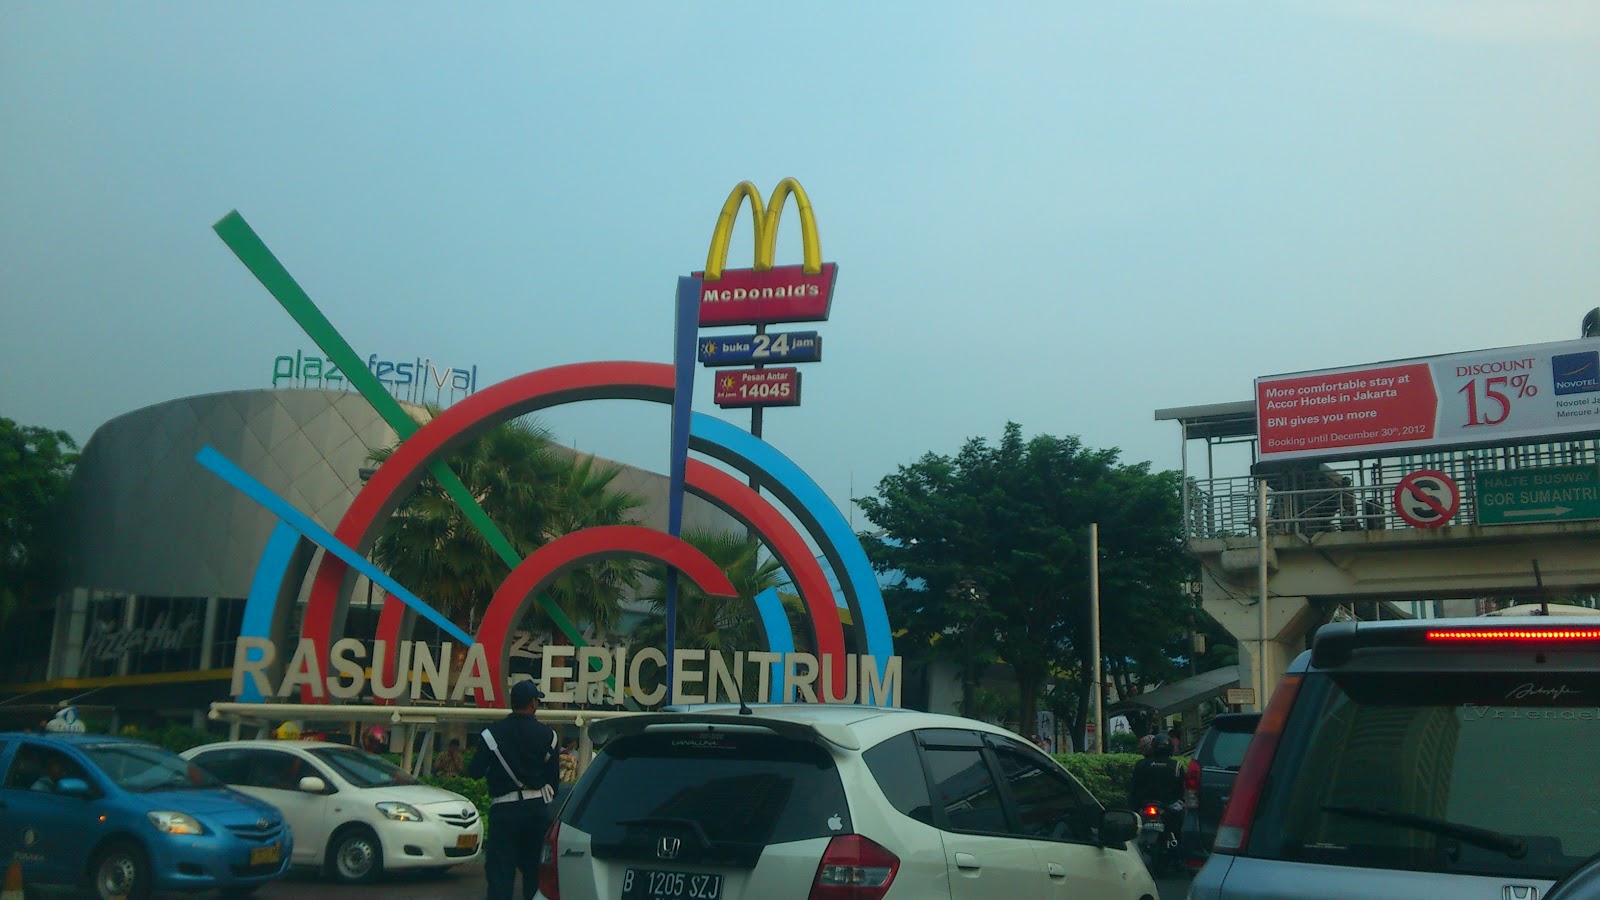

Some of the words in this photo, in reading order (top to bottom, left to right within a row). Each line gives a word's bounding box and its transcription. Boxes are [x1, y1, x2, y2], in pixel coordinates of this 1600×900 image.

[703, 283, 819, 302] McDonald's
[722, 343, 750, 352] buka
[752, 333, 789, 358] 24
[791, 338, 814, 349] jam
[272, 349, 345, 385] plaz
[368, 353, 477, 392] festival
[742, 373, 765, 381] Pesan
[767, 372, 788, 380] Antar
[1456, 358, 1536, 377] DISCOUNT
[739, 383, 790, 398] 14045
[1266, 388, 1295, 398] More
[1297, 380, 1366, 395] comfortable
[1370, 377, 1395, 388] stay
[1398, 374, 1410, 384] at
[1557, 378, 1599, 389] NOVOTEL
[1267, 400, 1298, 410] Accor
[1301, 394, 1337, 406] Hotels
[1339, 392, 1350, 402] in
[1353, 388, 1398, 400] Jakarta
[1458, 374, 1538, 428] 15%
[1556, 398, 1590, 408] Novotel
[1267, 417, 1287, 428] BNI
[1290, 413, 1320, 427] gives
[1322, 413, 1344, 425] you
[1347, 409, 1377, 420] more
[1557, 410, 1592, 418] Mercure
[1268, 435, 1306, 448] Booking
[1308, 432, 1329, 444] until
[1331, 429, 1379, 442] December
[1402, 424, 1426, 436] 2012
[1484, 475, 1528, 488] HALTE
[1534, 471, 1590, 485] BUSWAY
[1484, 492, 1517, 506] GOR
[1520, 486, 1597, 504] SUMANTRI
[230, 637, 495, 702] RASUNA
[539, 644, 903, 708] EPICENTRUM
[623, 869, 635, 892] B
[648, 871, 686, 896] 1205
[688, 875, 720, 899] SZJ
